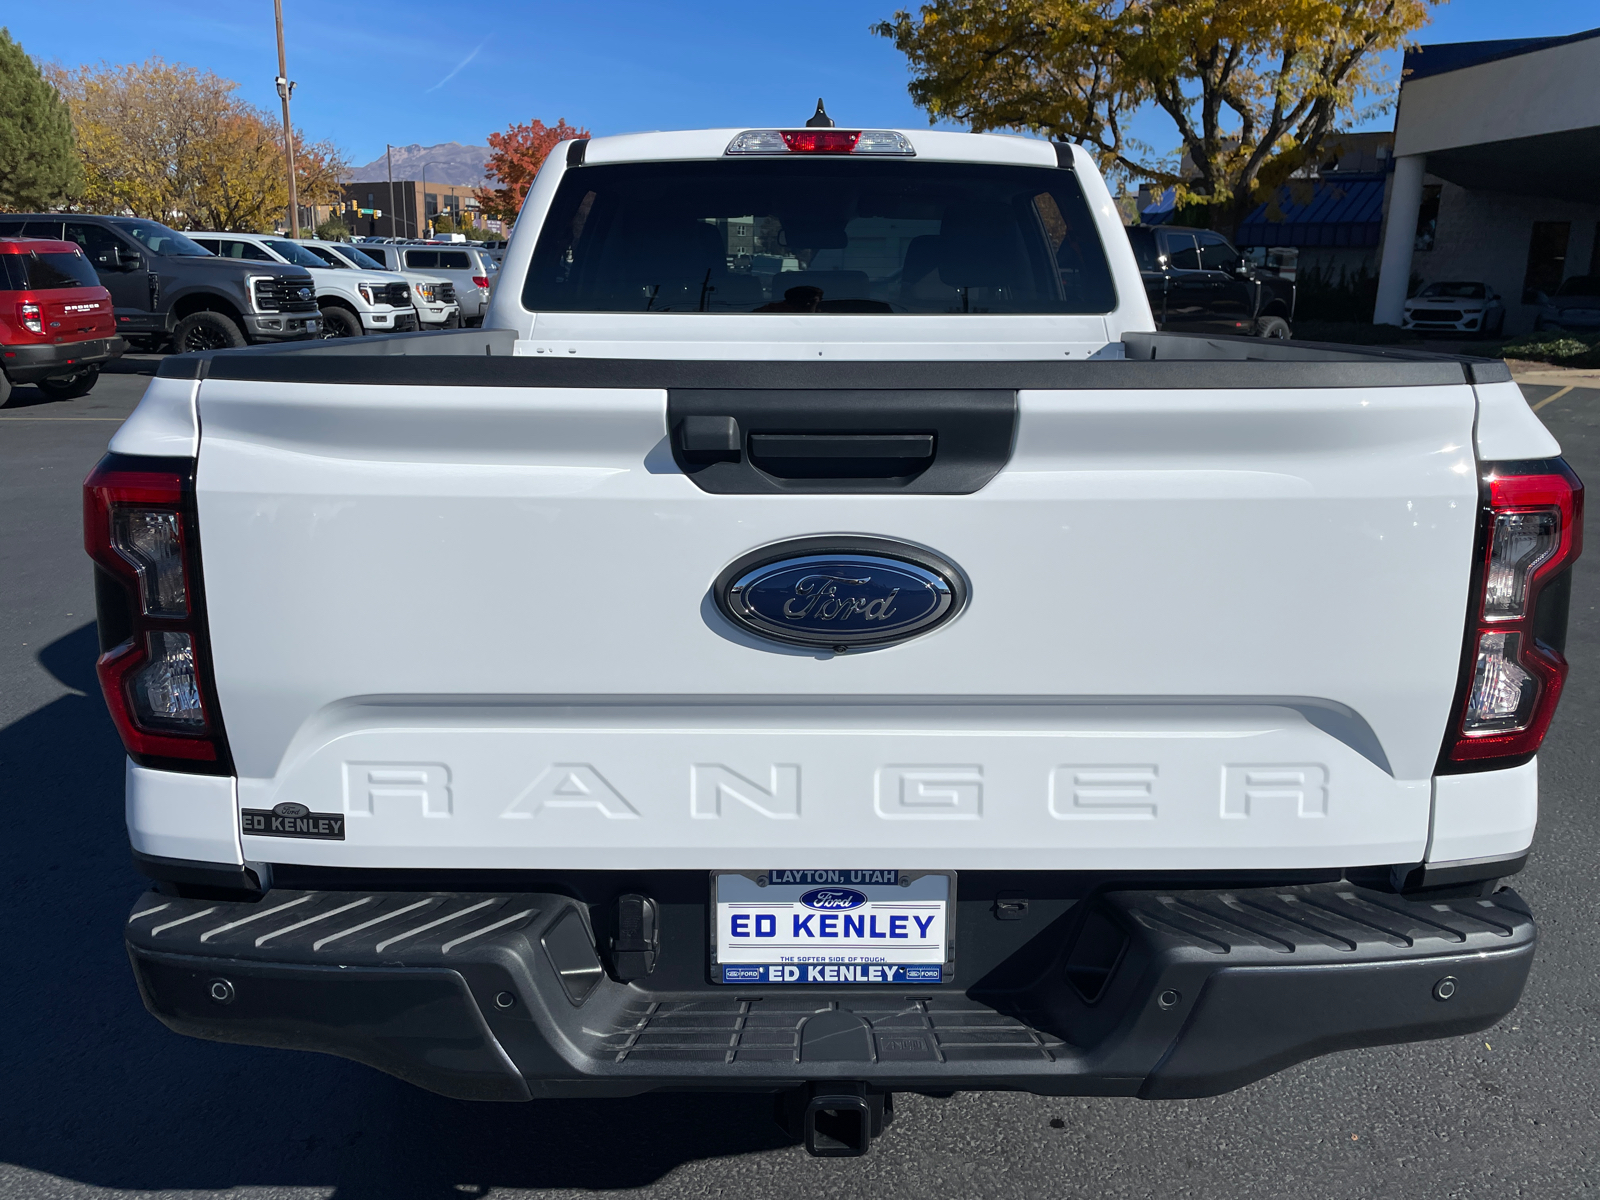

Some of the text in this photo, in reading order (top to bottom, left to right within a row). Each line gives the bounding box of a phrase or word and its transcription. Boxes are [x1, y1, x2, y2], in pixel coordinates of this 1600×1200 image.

[783, 574, 900, 621] Ford
[341, 760, 1330, 820] RANGER
[281, 805, 301, 815] Ford
[242, 815, 342, 834] ED KENLEY
[772, 870, 896, 883] LAYTON, UTAH
[813, 890, 853, 908] Ford
[730, 914, 936, 939] ED KENLEY
[768, 965, 899, 982] ED KENLEY
